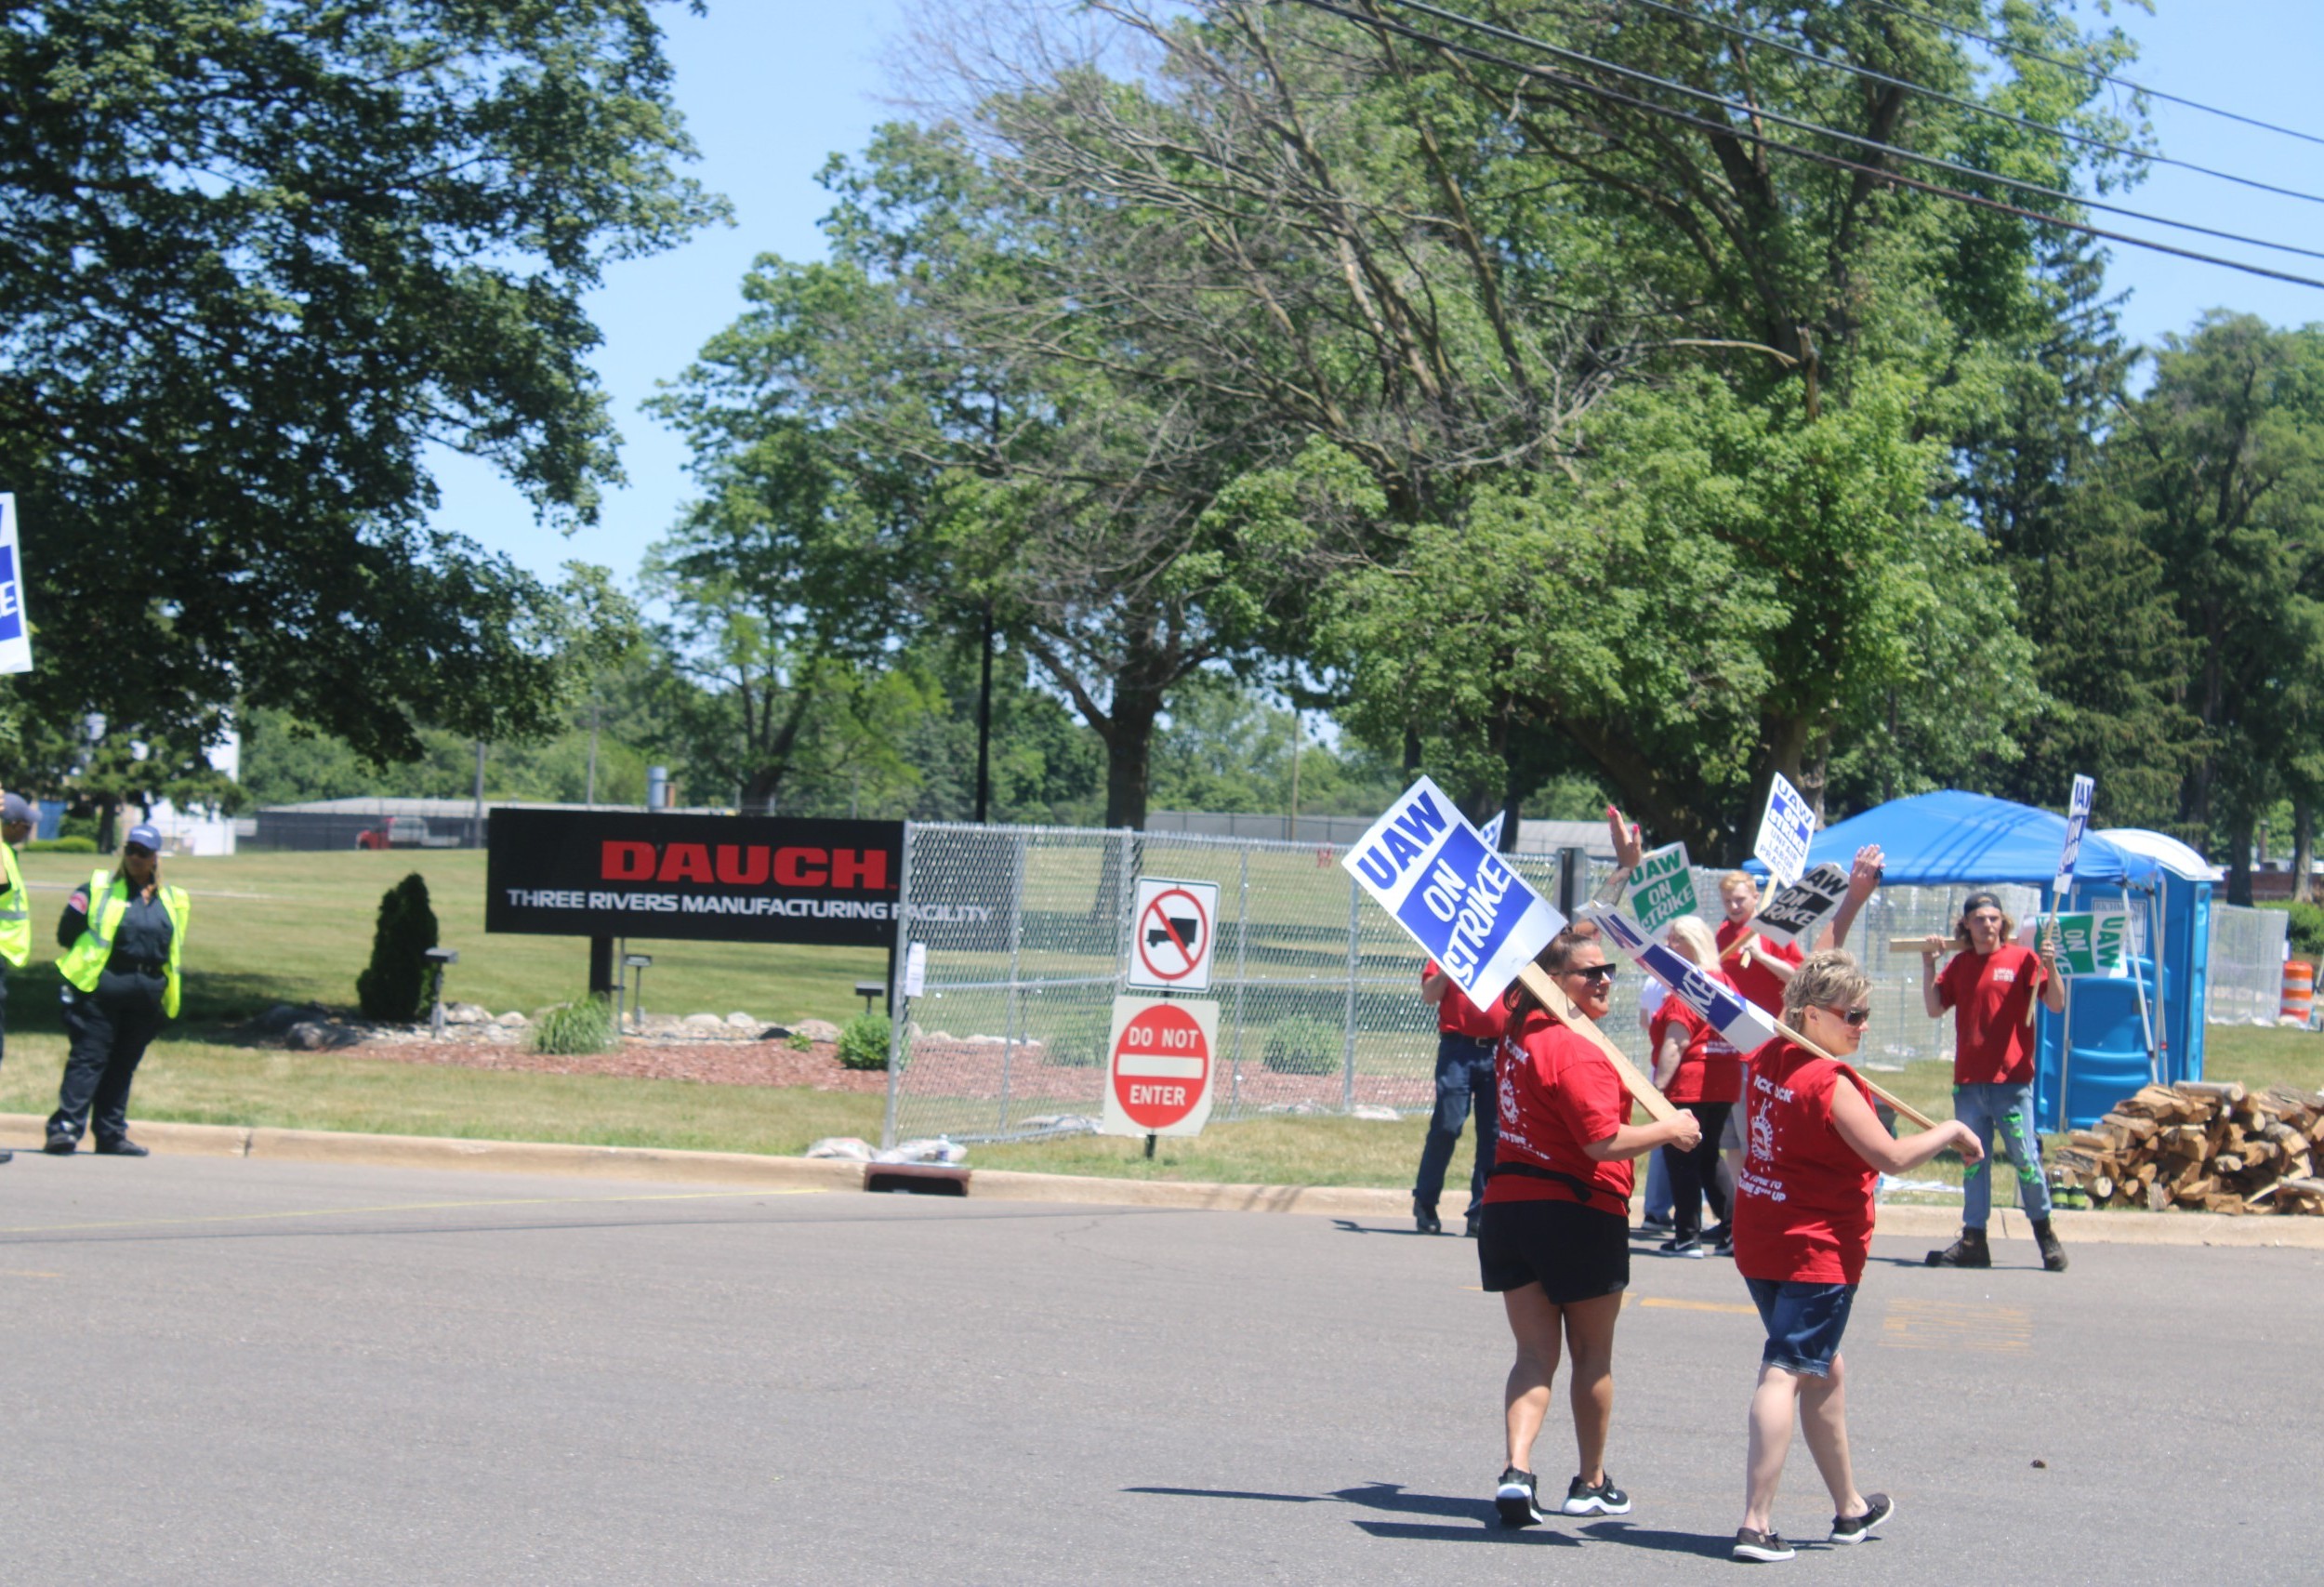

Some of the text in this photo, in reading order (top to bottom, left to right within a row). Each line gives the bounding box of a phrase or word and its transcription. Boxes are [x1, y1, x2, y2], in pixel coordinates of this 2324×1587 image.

[1777, 779, 1812, 825] UAW
[1783, 806, 1801, 831] ON
[1355, 789, 1447, 891] UAW
[1768, 808, 1806, 856] STRIKE
[1770, 828, 1798, 862] UNFAIR
[601, 840, 888, 890] DAUCH
[1630, 849, 1681, 886] UAW
[1768, 840, 1794, 871] LABOR
[1422, 858, 1466, 922] ON
[1648, 879, 1672, 906] ON
[1777, 888, 1814, 908] ON
[1805, 868, 1849, 897] AW
[507, 889, 993, 921] THREE RIVERS MANUFACTURING FACILITY
[1442, 853, 1512, 987] STRIKE
[1641, 882, 1694, 932] STRIKE
[2064, 930, 2090, 952] ON
[2097, 916, 2126, 970] UAW
[1128, 1026, 1199, 1049] DO NOT
[1129, 1083, 1186, 1106] ENTER
[1771, 1190, 1787, 1202] UP
